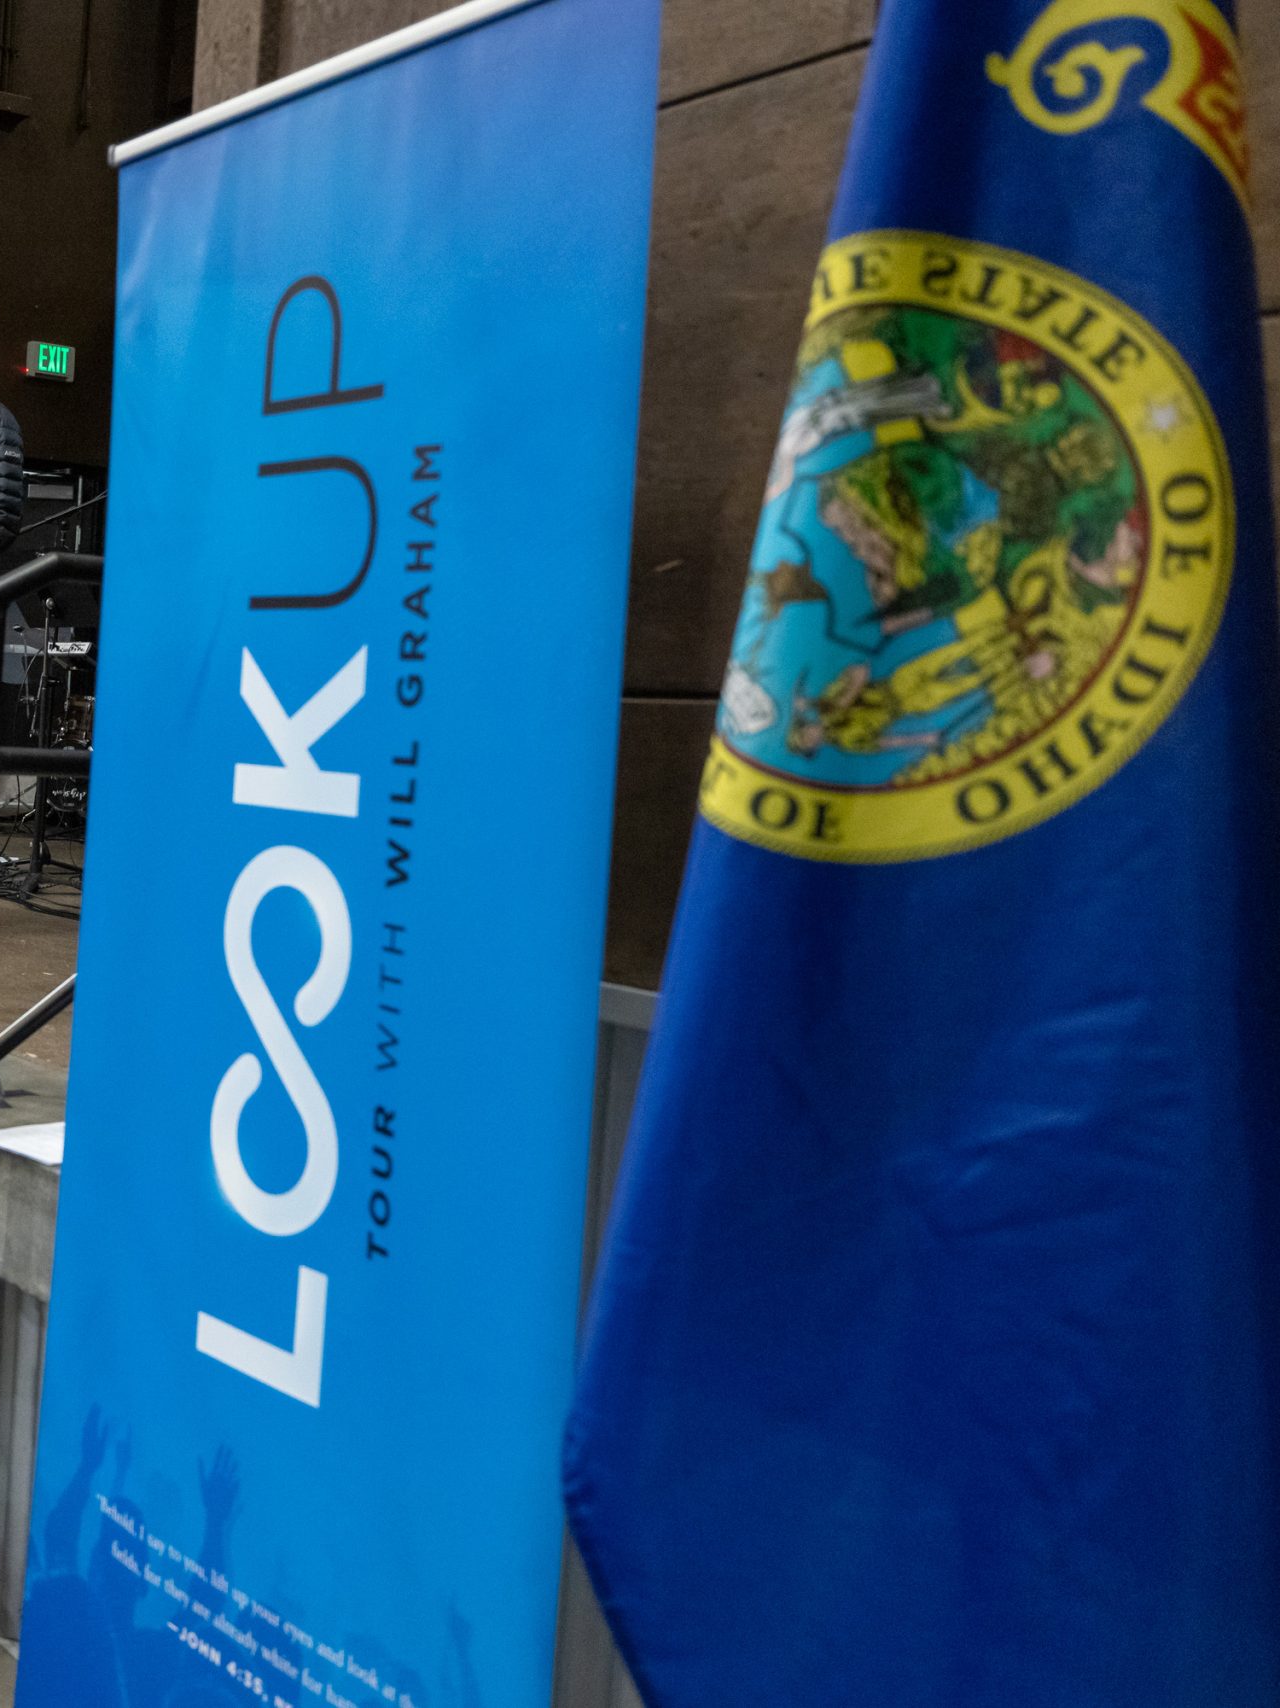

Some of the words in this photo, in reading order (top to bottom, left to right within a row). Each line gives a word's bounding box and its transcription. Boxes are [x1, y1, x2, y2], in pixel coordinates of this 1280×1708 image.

[38, 343, 70, 375] EXIT
[397, 444, 443, 708] GRAHAM
[385, 740, 420, 888] WILL
[375, 923, 407, 1072] WITH
[367, 1105, 397, 1261] TOUR
[144, 1564, 161, 1588] for
[164, 1578, 190, 1609] they
[213, 1613, 259, 1656] already
[301, 1668, 323, 1696] for
[147, 1534, 165, 1557] say
[168, 1545, 182, 1562] to
[232, 1588, 249, 1610] up
[251, 1600, 280, 1628] your
[283, 1621, 314, 1650] eyes
[316, 1643, 344, 1668] and
[347, 1655, 378, 1690] look
